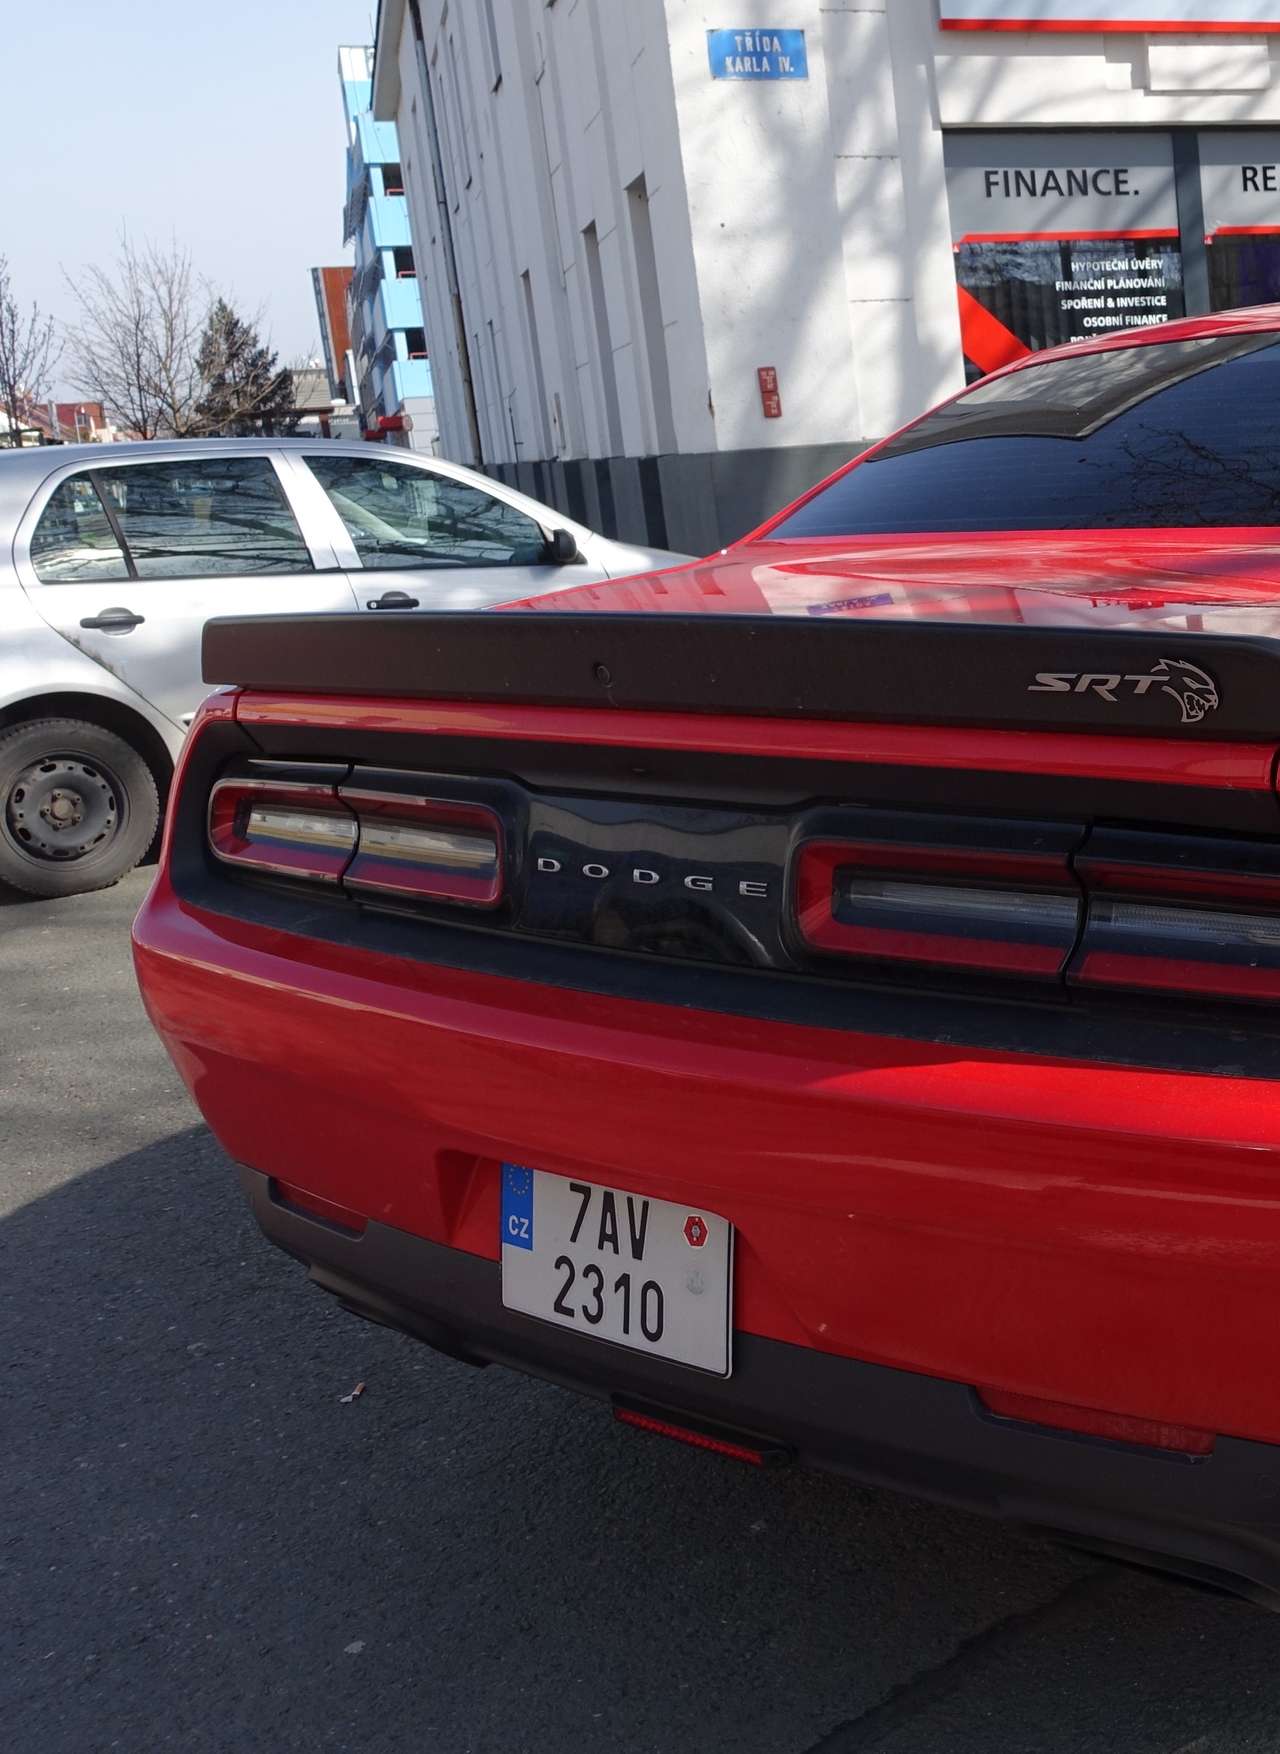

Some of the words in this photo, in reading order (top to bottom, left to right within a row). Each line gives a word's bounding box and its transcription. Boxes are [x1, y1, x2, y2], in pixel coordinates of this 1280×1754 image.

[734, 31, 781, 52] TŘÍDA
[725, 56, 770, 72] KARLA
[778, 56, 795, 72] IV.
[984, 168, 1140, 198] FINANCE.
[1071, 258, 1129, 273] HYPOTEČNÍ
[1131, 257, 1164, 271] ÚVĚRY
[1055, 278, 1105, 292] FINANČNÍ
[1107, 276, 1166, 290] PLÁNOVÁNÍ
[1061, 296, 1105, 310] SPOŘENÍ
[1106, 297, 1116, 308] &
[1116, 296, 1167, 308] INVESTICE
[1083, 314, 1123, 328] OSOBNÍ
[1027, 673, 1171, 702] SRT
[537, 857, 769, 898] DODGE
[508, 1214, 529, 1239] CZ
[569, 1181, 650, 1262] 7AV
[553, 1254, 664, 1343] 2310
